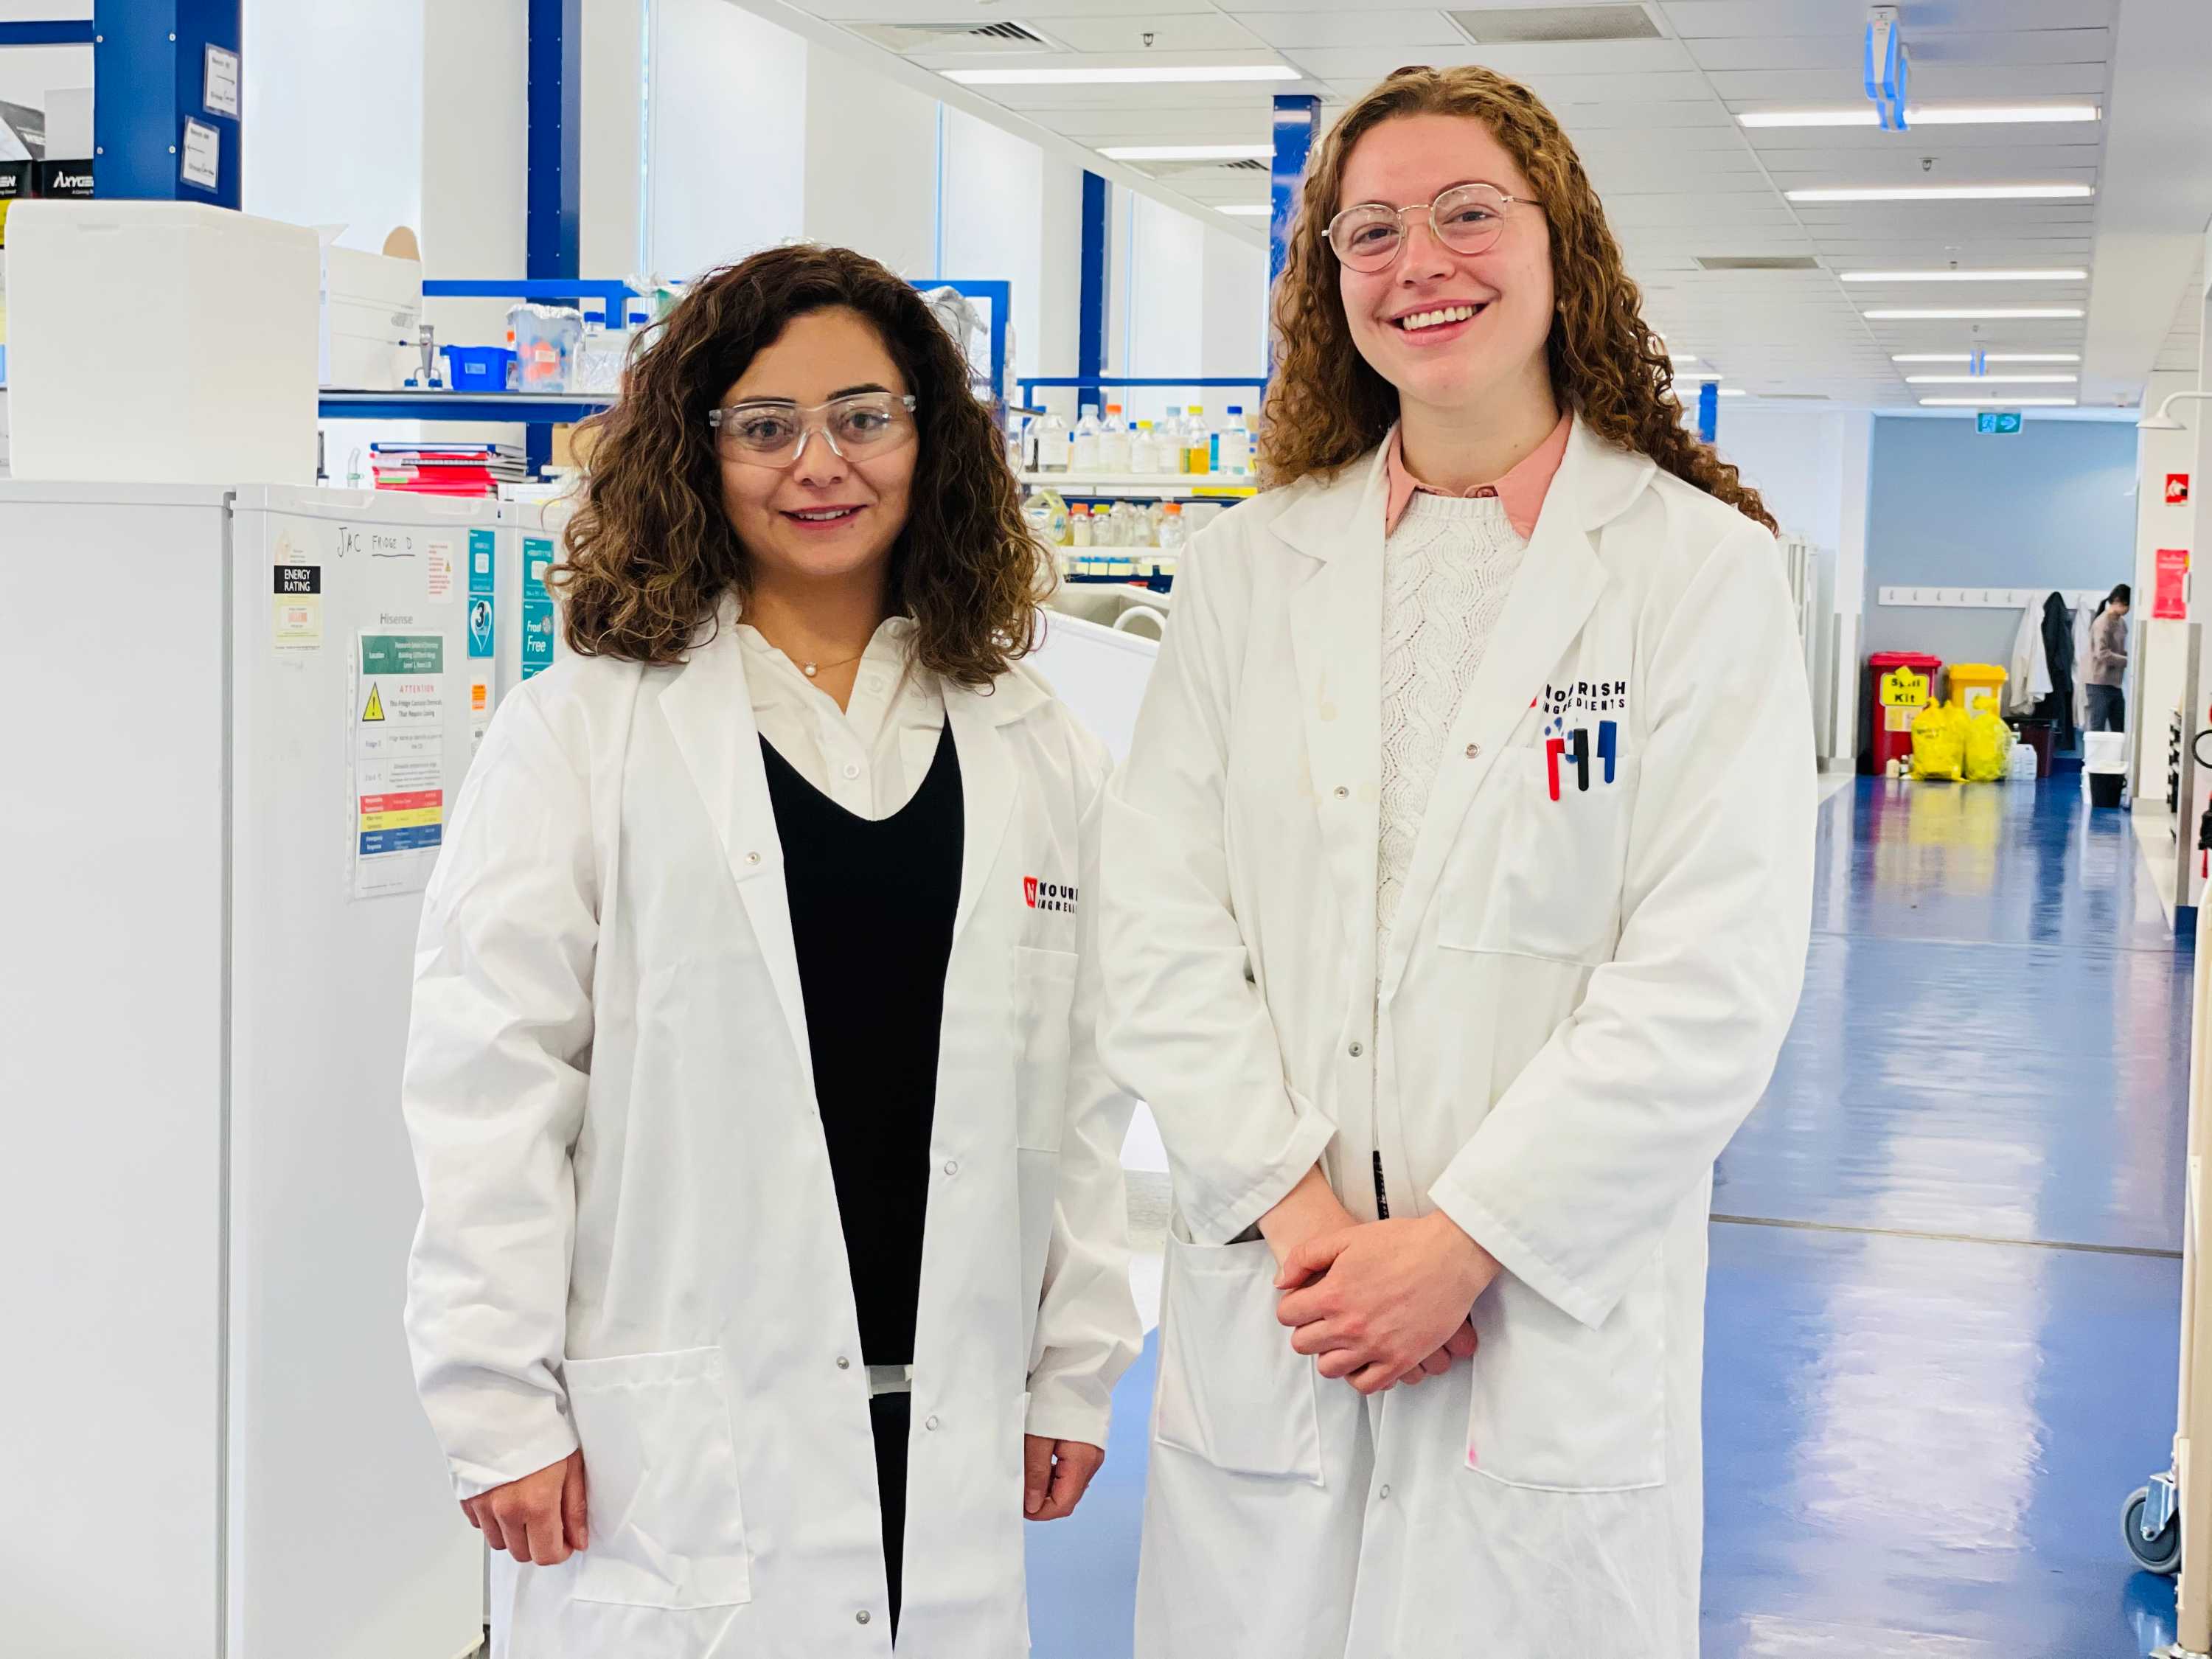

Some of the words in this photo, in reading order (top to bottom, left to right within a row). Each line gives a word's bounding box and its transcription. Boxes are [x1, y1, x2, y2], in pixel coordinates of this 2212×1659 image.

[53, 170, 94, 188] AXYGE
[337, 526, 361, 557] JAC
[284, 568, 311, 580] ENERGY
[284, 581, 311, 592] RATING
[380, 613, 413, 625] Hisense
[476, 602, 485, 628] 3
[526, 636, 546, 653] Free
[400, 684, 434, 694] ATTENTION
[1895, 693, 1915, 703] Kit
